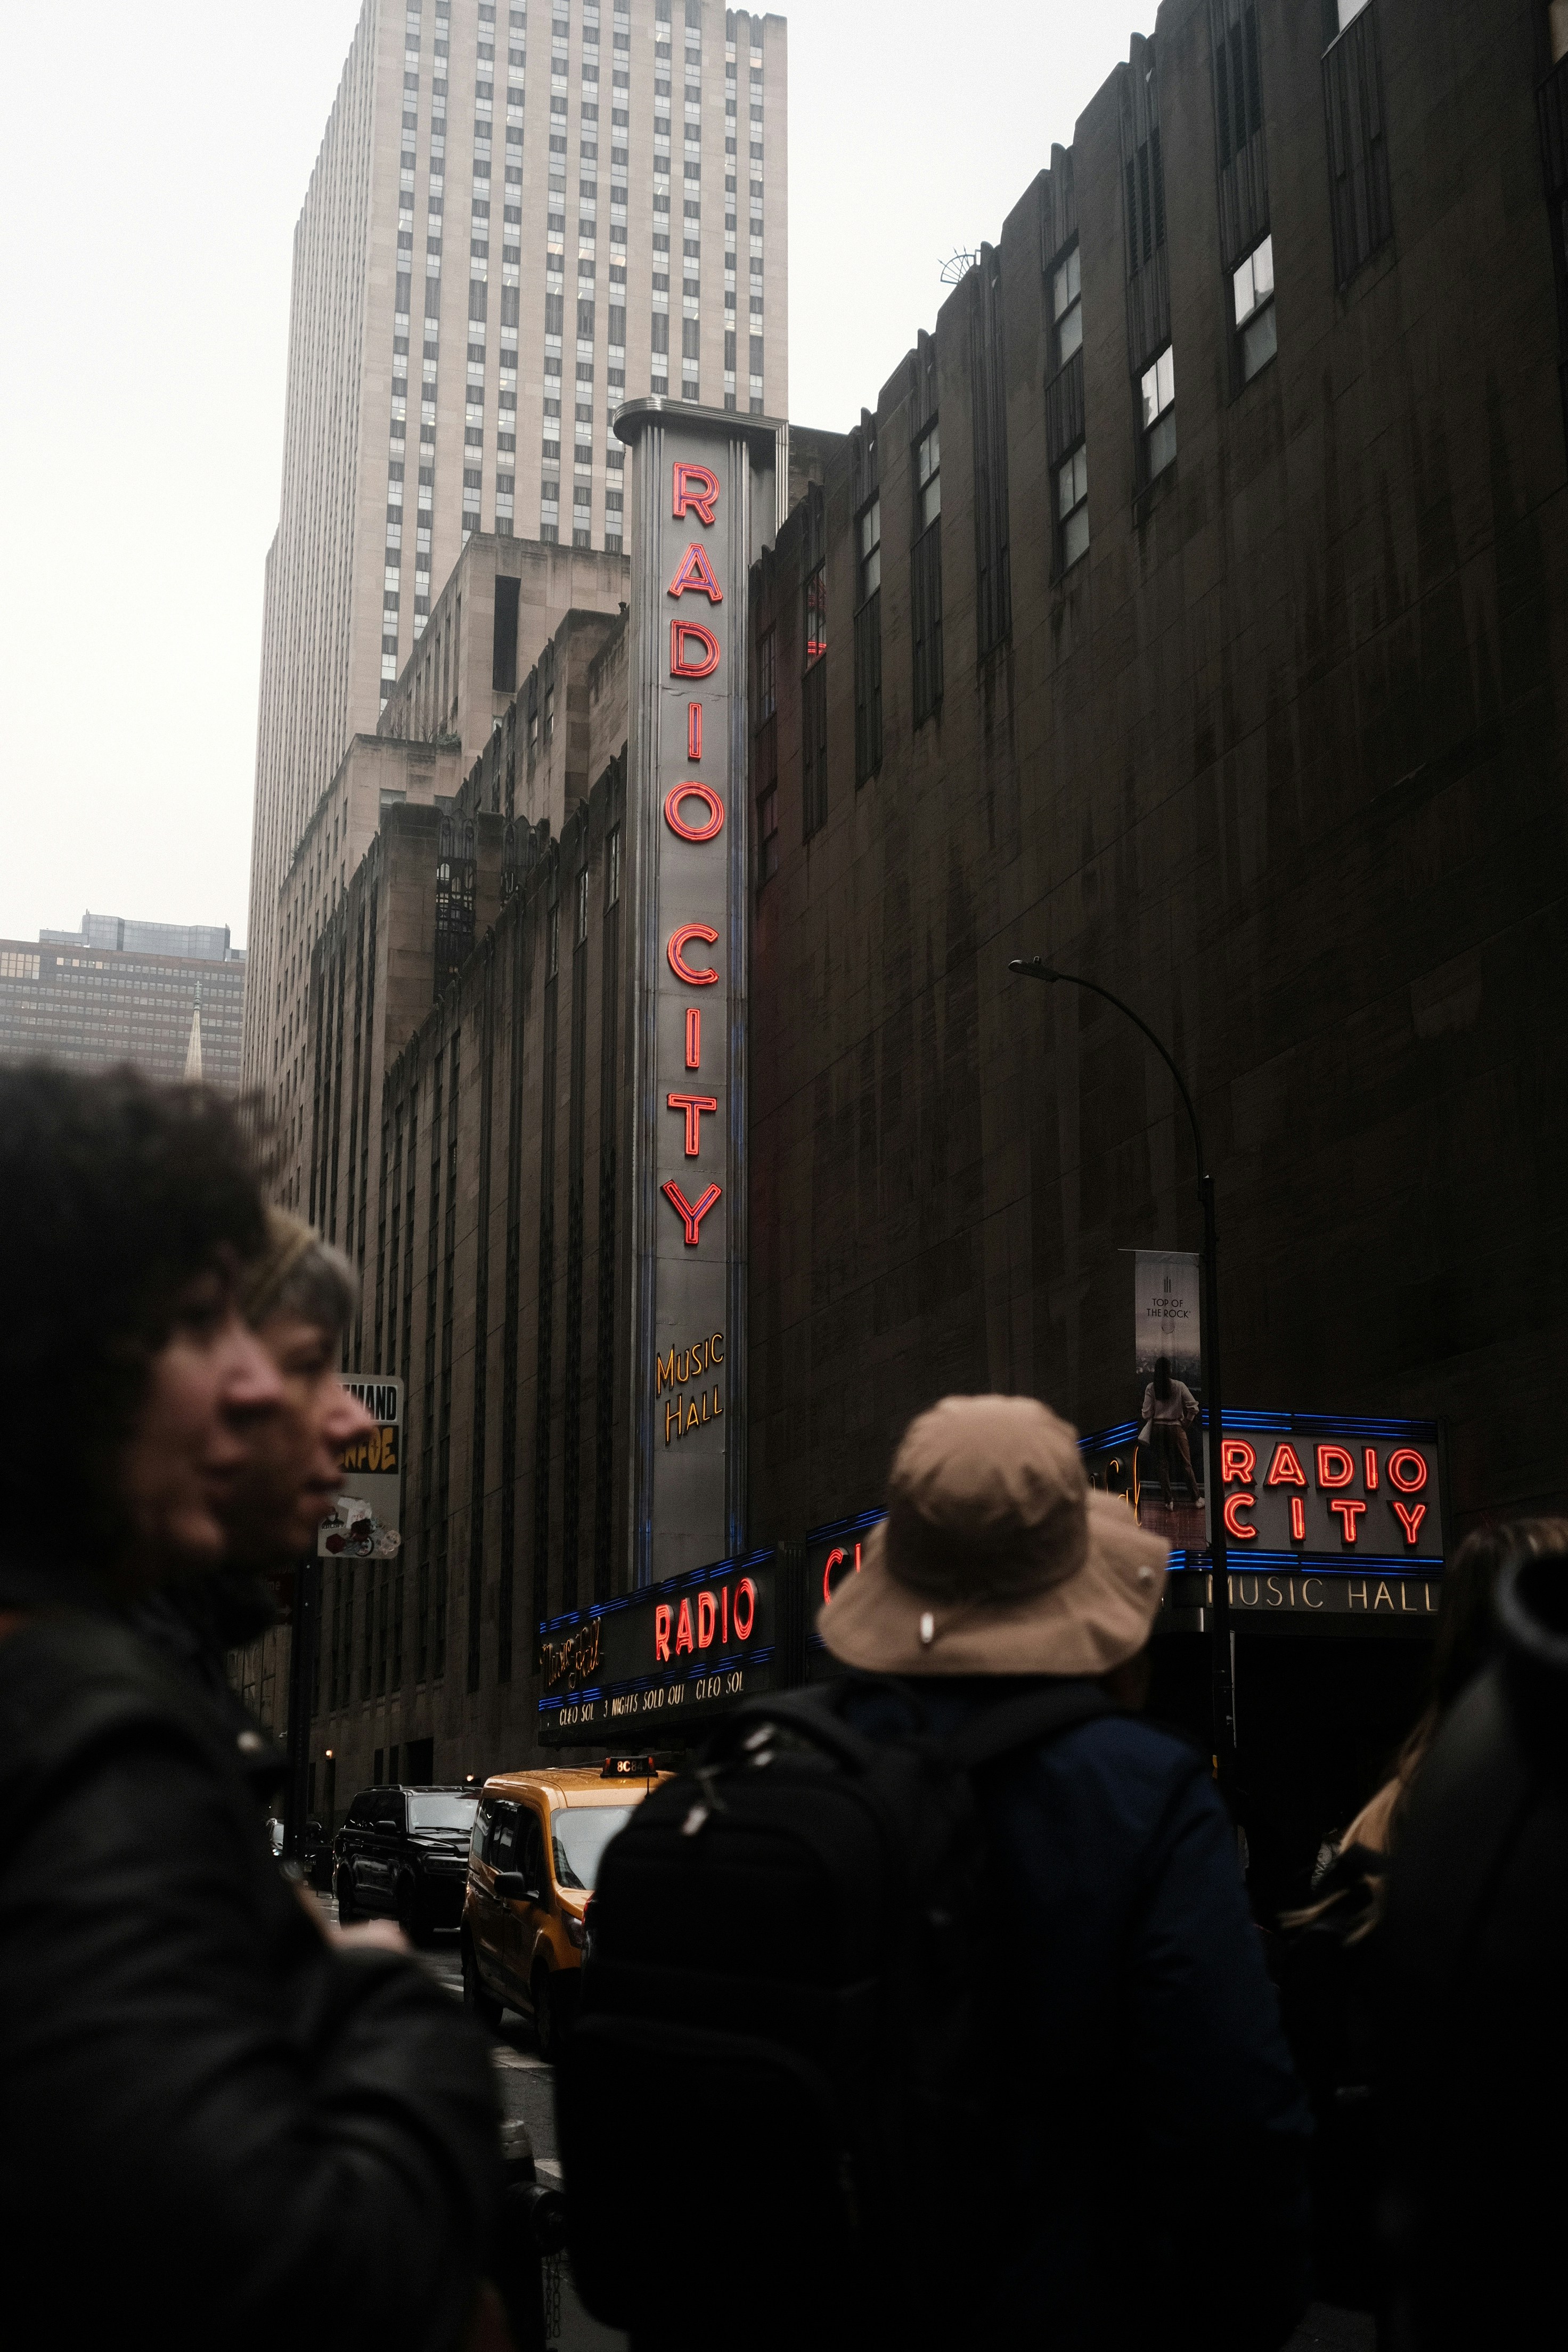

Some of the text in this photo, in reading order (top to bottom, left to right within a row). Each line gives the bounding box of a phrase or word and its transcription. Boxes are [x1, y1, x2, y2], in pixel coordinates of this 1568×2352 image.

[661, 462, 725, 1245] RADIO CITY
[1171, 1299, 1183, 1308] OF
[1221, 1438, 1428, 1493] RADIO
[1224, 1492, 1429, 1545] CITY
[656, 1578, 756, 1662] RADIO
[1348, 1580, 1438, 1612] HALL
[559, 1671, 744, 1726] CLEO SOL 3 NIGHTS SOLD OUT CLEO SOL
